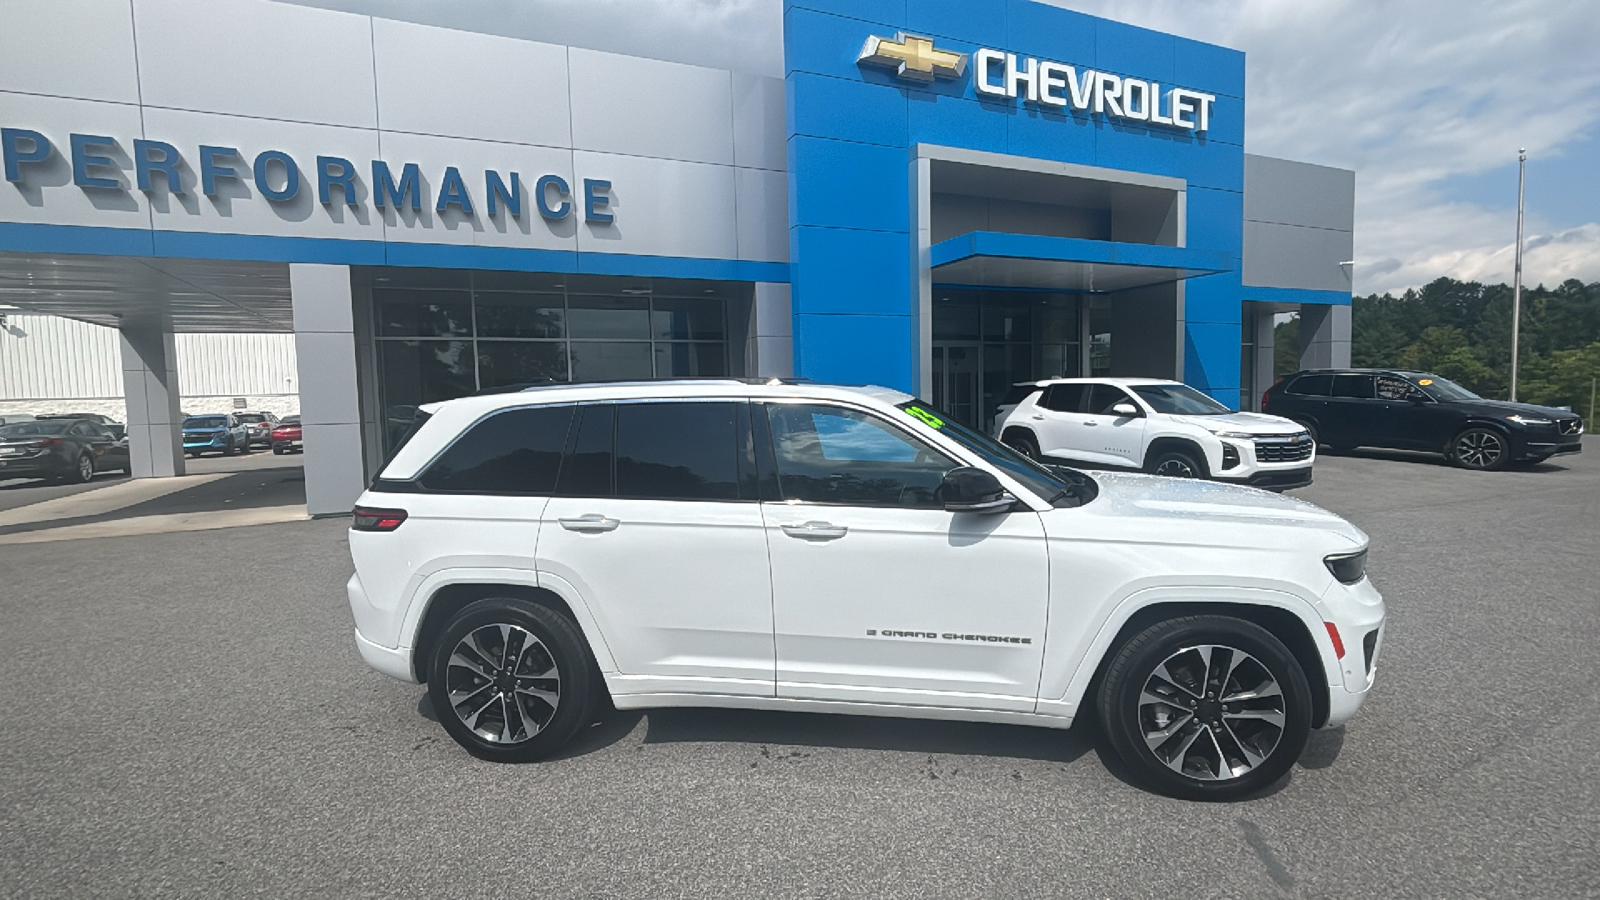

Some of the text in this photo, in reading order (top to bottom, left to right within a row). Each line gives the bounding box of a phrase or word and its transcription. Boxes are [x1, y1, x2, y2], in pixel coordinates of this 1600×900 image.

[974, 47, 1215, 131] CHEVROLET
[1, 127, 613, 223] PERFORMANCE
[881, 630, 937, 639] GRAND
[942, 633, 1032, 644] CHEROKEE
